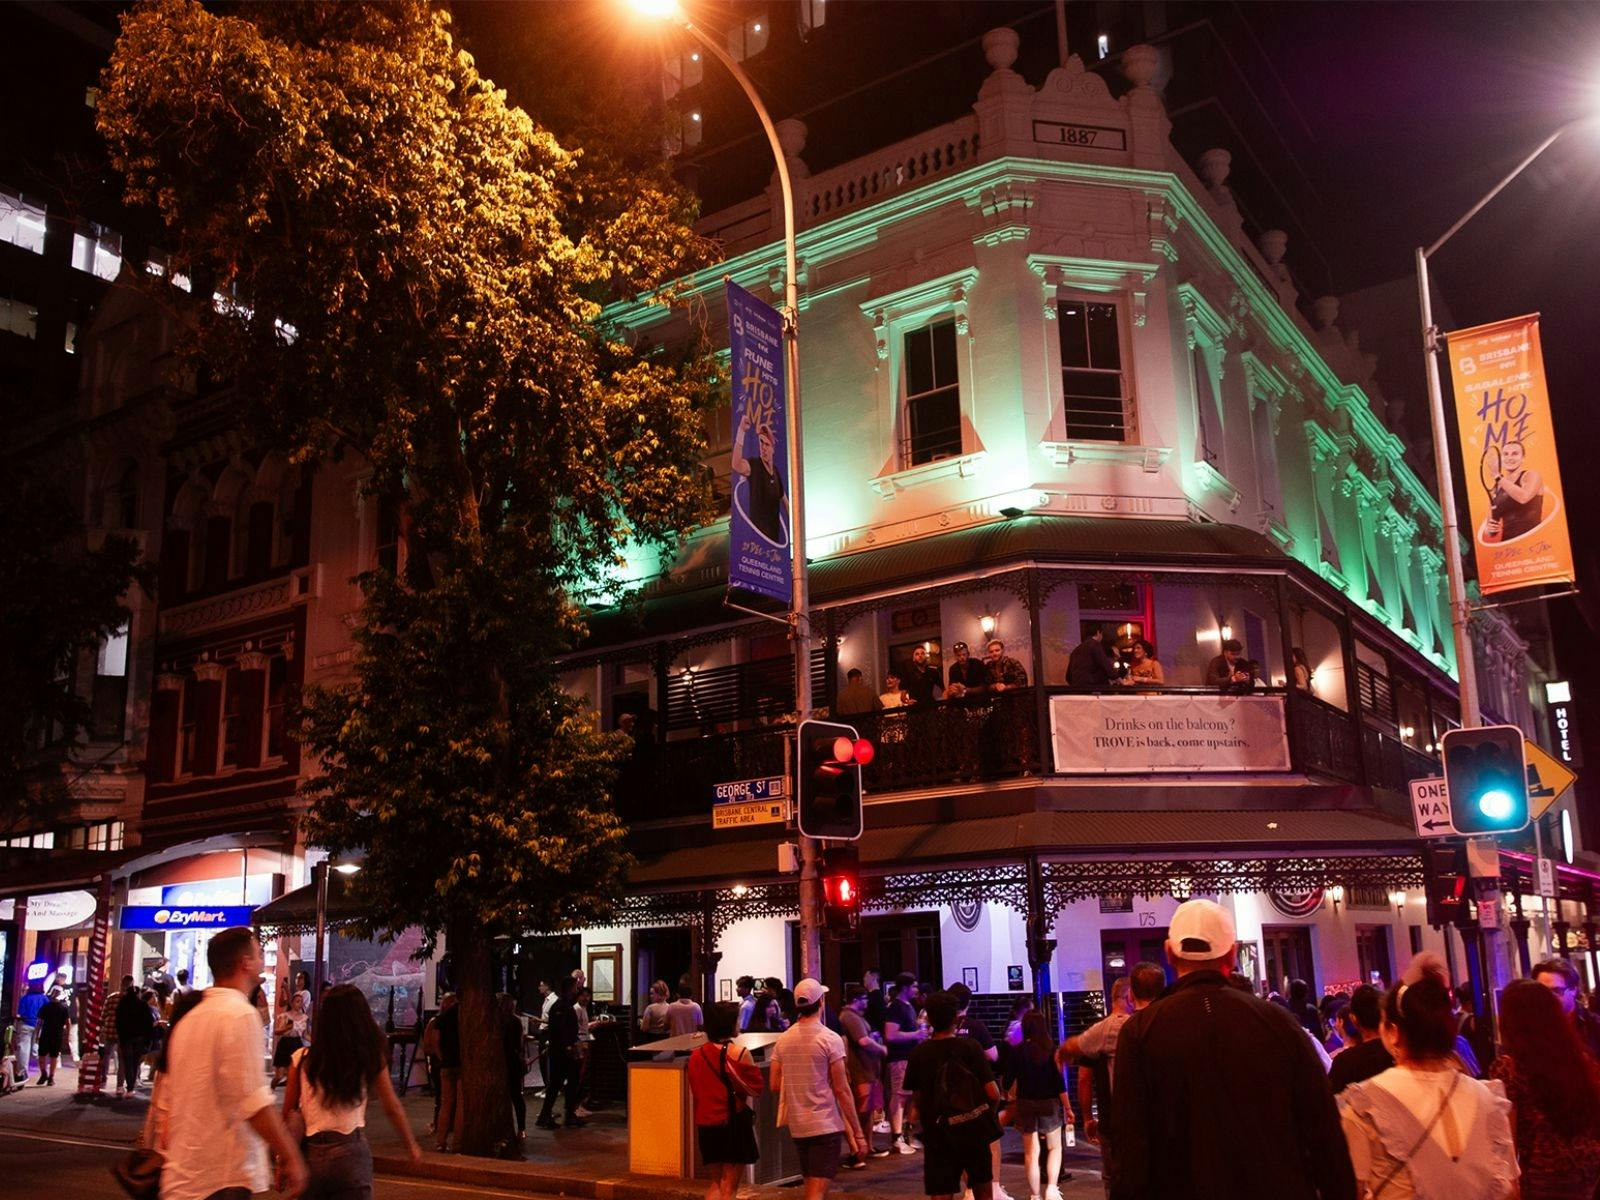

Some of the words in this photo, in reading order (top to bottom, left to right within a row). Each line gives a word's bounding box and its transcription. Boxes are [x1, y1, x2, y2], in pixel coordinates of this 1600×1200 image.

[1060, 128, 1098, 144] 1887
[745, 321, 778, 348] BRISBANE
[744, 347, 774, 373] RUNE
[1479, 343, 1529, 362] BRISBANE
[741, 556, 782, 575] QUEENSLAND
[1491, 567, 1522, 578] TENNIS
[1523, 562, 1560, 573] CENTRE
[1494, 556, 1554, 570] QUEENSLAND
[738, 564, 760, 577] TENNIS
[760, 571, 784, 585] CENTRE
[1104, 717, 1146, 731] Drinks
[1148, 720, 1163, 731] on
[1166, 717, 1183, 731] the
[1186, 717, 1236, 734] balcony?
[1556, 708, 1572, 761] HOTEL
[1093, 736, 1135, 748] TROVE
[1136, 736, 1145, 748] is
[1147, 736, 1176, 748] back,
[1177, 739, 1204, 748] come
[1206, 736, 1250, 750] upstairs.
[716, 783, 751, 799] GEORGE
[1418, 784, 1447, 799] ONE
[716, 807, 742, 819] BRISBANE
[743, 805, 768, 815] CENTRAL
[716, 817, 738, 826] TRAFFIC
[740, 815, 755, 824] AREA
[1139, 912, 1156, 927] 175
